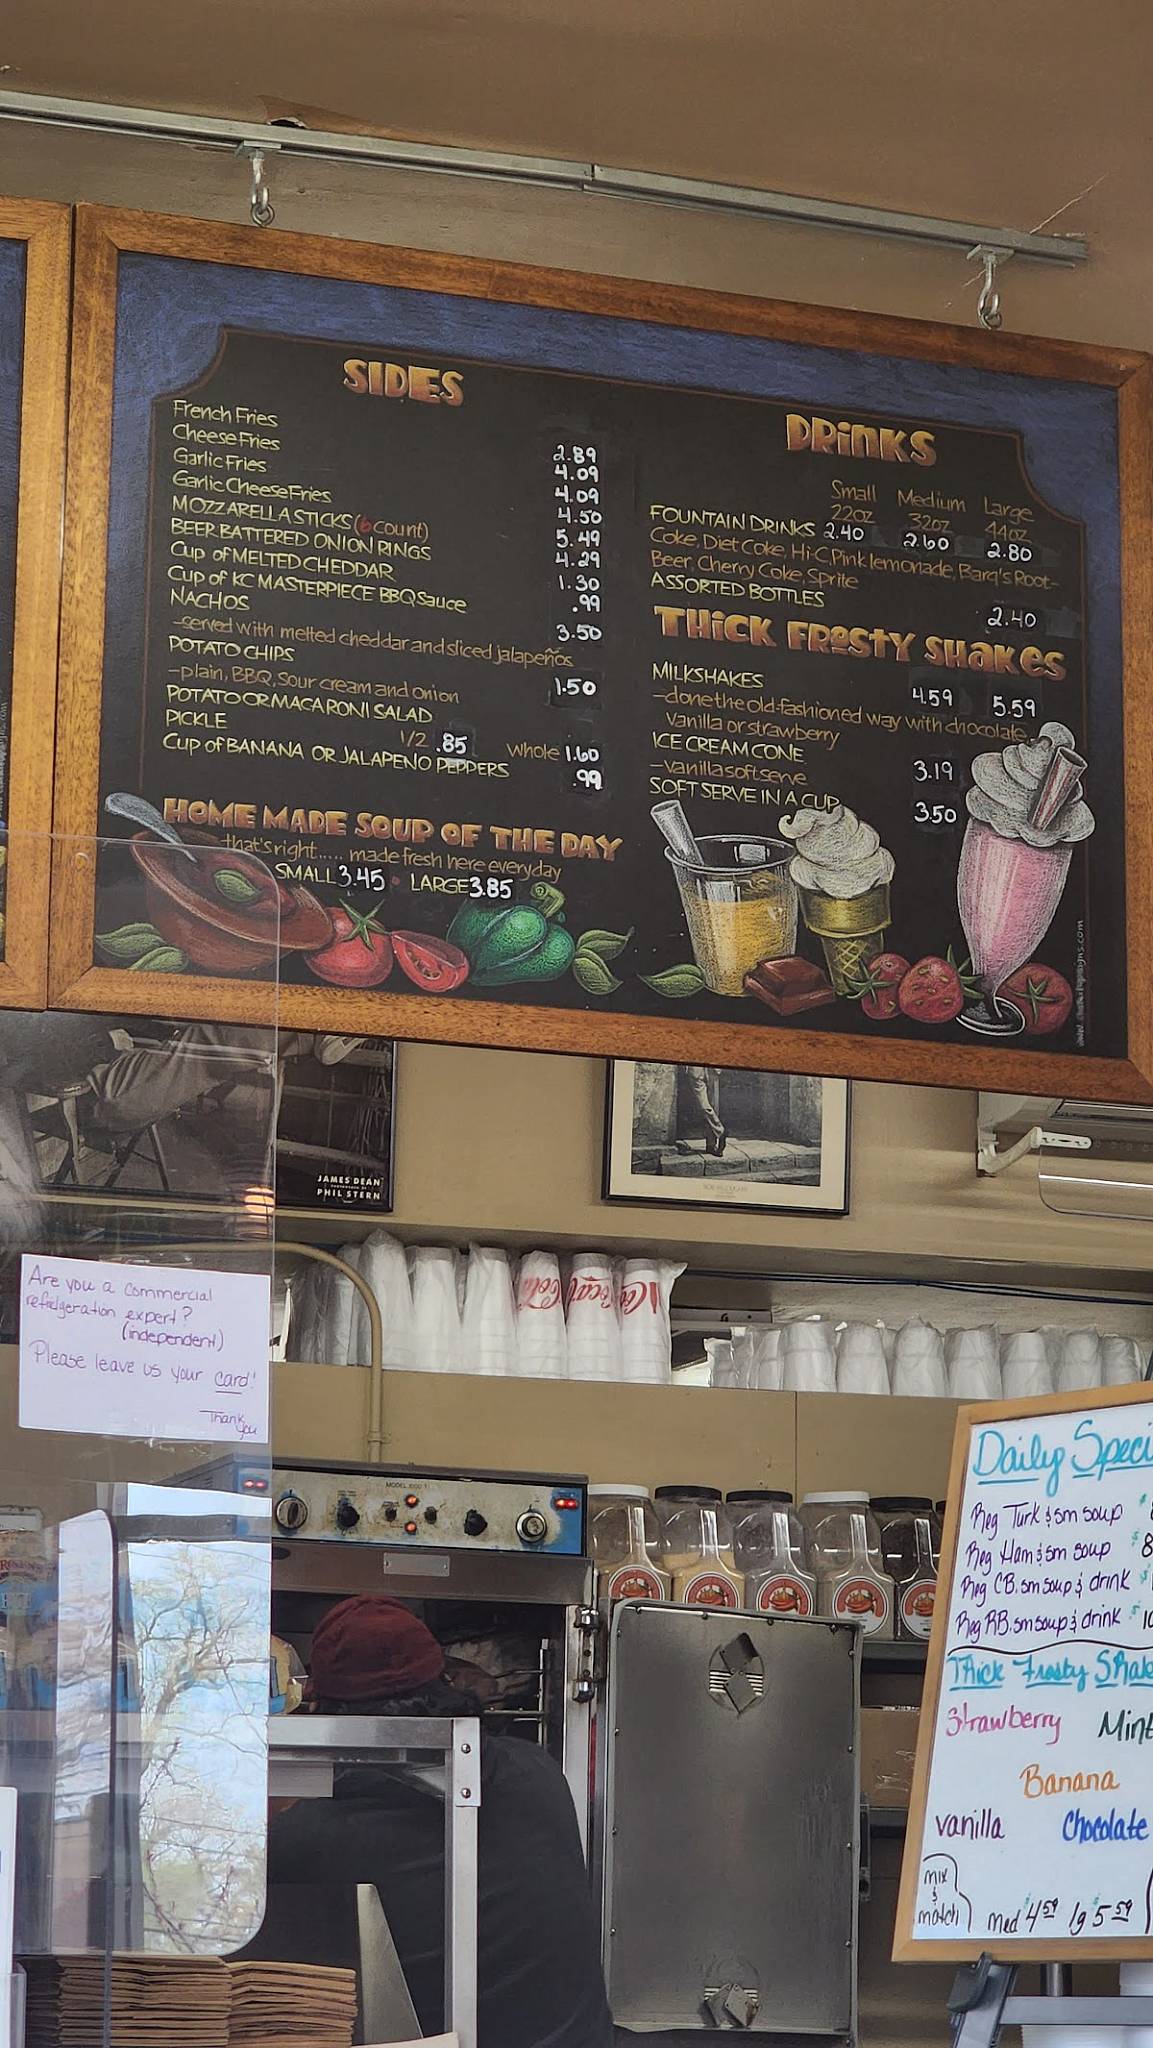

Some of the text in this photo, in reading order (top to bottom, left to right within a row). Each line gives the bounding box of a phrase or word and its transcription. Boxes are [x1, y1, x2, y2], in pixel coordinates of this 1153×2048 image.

[343, 359, 464, 406] SIDES
[173, 400, 278, 427] French Fries
[172, 423, 280, 450] Cheese Fries
[173, 447, 267, 472] Garlic Fries
[553, 444, 597, 464] 2.89
[172, 469, 332, 503] Garlic Cheese Fries
[554, 464, 599, 483] 4.09
[554, 485, 599, 504] 4.09
[831, 480, 1034, 524] Small Medium Large
[172, 494, 353, 529] MOZZARELLA STICKS
[557, 506, 602, 524] 4.50
[171, 517, 432, 560] BEER BATTERED ONION RINGS
[556, 528, 600, 548] 5.49
[650, 504, 1032, 562] FOUNTAIN DRINKS 2.40 2.60 2.80
[170, 541, 396, 582] Cup of MELTED CHEDDAR
[555, 551, 600, 568] 4.29
[697, 555, 859, 589] Cherry Sprite
[703, 534, 1011, 586] Diet Pink Barq's
[168, 565, 467, 614] Cup of KC MASTERPIECE BBQ Sauce
[171, 586, 250, 610] NACHOS
[559, 575, 600, 591] 1.30
[651, 571, 825, 608] ASSORTED BOTTLES
[572, 594, 600, 612] .99
[987, 606, 1036, 628] 2.40
[169, 635, 295, 661] POTATO CHIPS
[236, 621, 574, 669] with melted cheddar and sliced jalapeños
[556, 624, 602, 641] 3.50
[278, 672, 408, 697] Sour cream and
[554, 677, 597, 696] 1.50
[652, 661, 764, 688] MILKSHAKES
[166, 685, 432, 723] POTATO OR MACARONI SALAD
[715, 692, 1028, 742] the way with chocolate
[912, 687, 1036, 718] 4.59 5.59
[166, 710, 228, 729] PICKLE
[727, 720, 840, 750] or strawberry
[163, 732, 510, 778] Cup of BANANA OR JALAPENO PEPPERS
[401, 730, 599, 762] 1/2 1.60
[652, 731, 804, 763] ICE CREAM CONE
[728, 764, 807, 785] soft serve
[913, 760, 953, 782] 3.19
[650, 777, 957, 823] SOFT SERVE IN A CUP 3.50
[163, 798, 624, 861] HOME MADE SOUP OF THE DAY
[220, 833, 561, 884] that's made fresh here everyday
[275, 863, 513, 899] SMALL 3.45 LARGE 3.85
[317, 1175, 380, 1186] JAMES DEAN
[317, 1188, 380, 1200] PHIL STERN
[28, 1264, 114, 1293] Are you a
[122, 1321, 224, 1351] (independent)
[29, 1340, 202, 1384] Please leave us your
[972, 1430, 1065, 1496] Daily
[971, 1501, 1123, 1541] Reg Turk sm soup
[966, 1539, 1111, 1576] Reg Ham sm soup
[1021, 1569, 1130, 1597] sm soup drink
[1035, 1604, 1121, 1637] soup drink
[945, 1702, 1061, 1745] Strawberry
[1020, 1763, 1120, 1798] Banana
[1062, 1807, 1149, 1844] Chocolate
[918, 1903, 959, 1927] match
